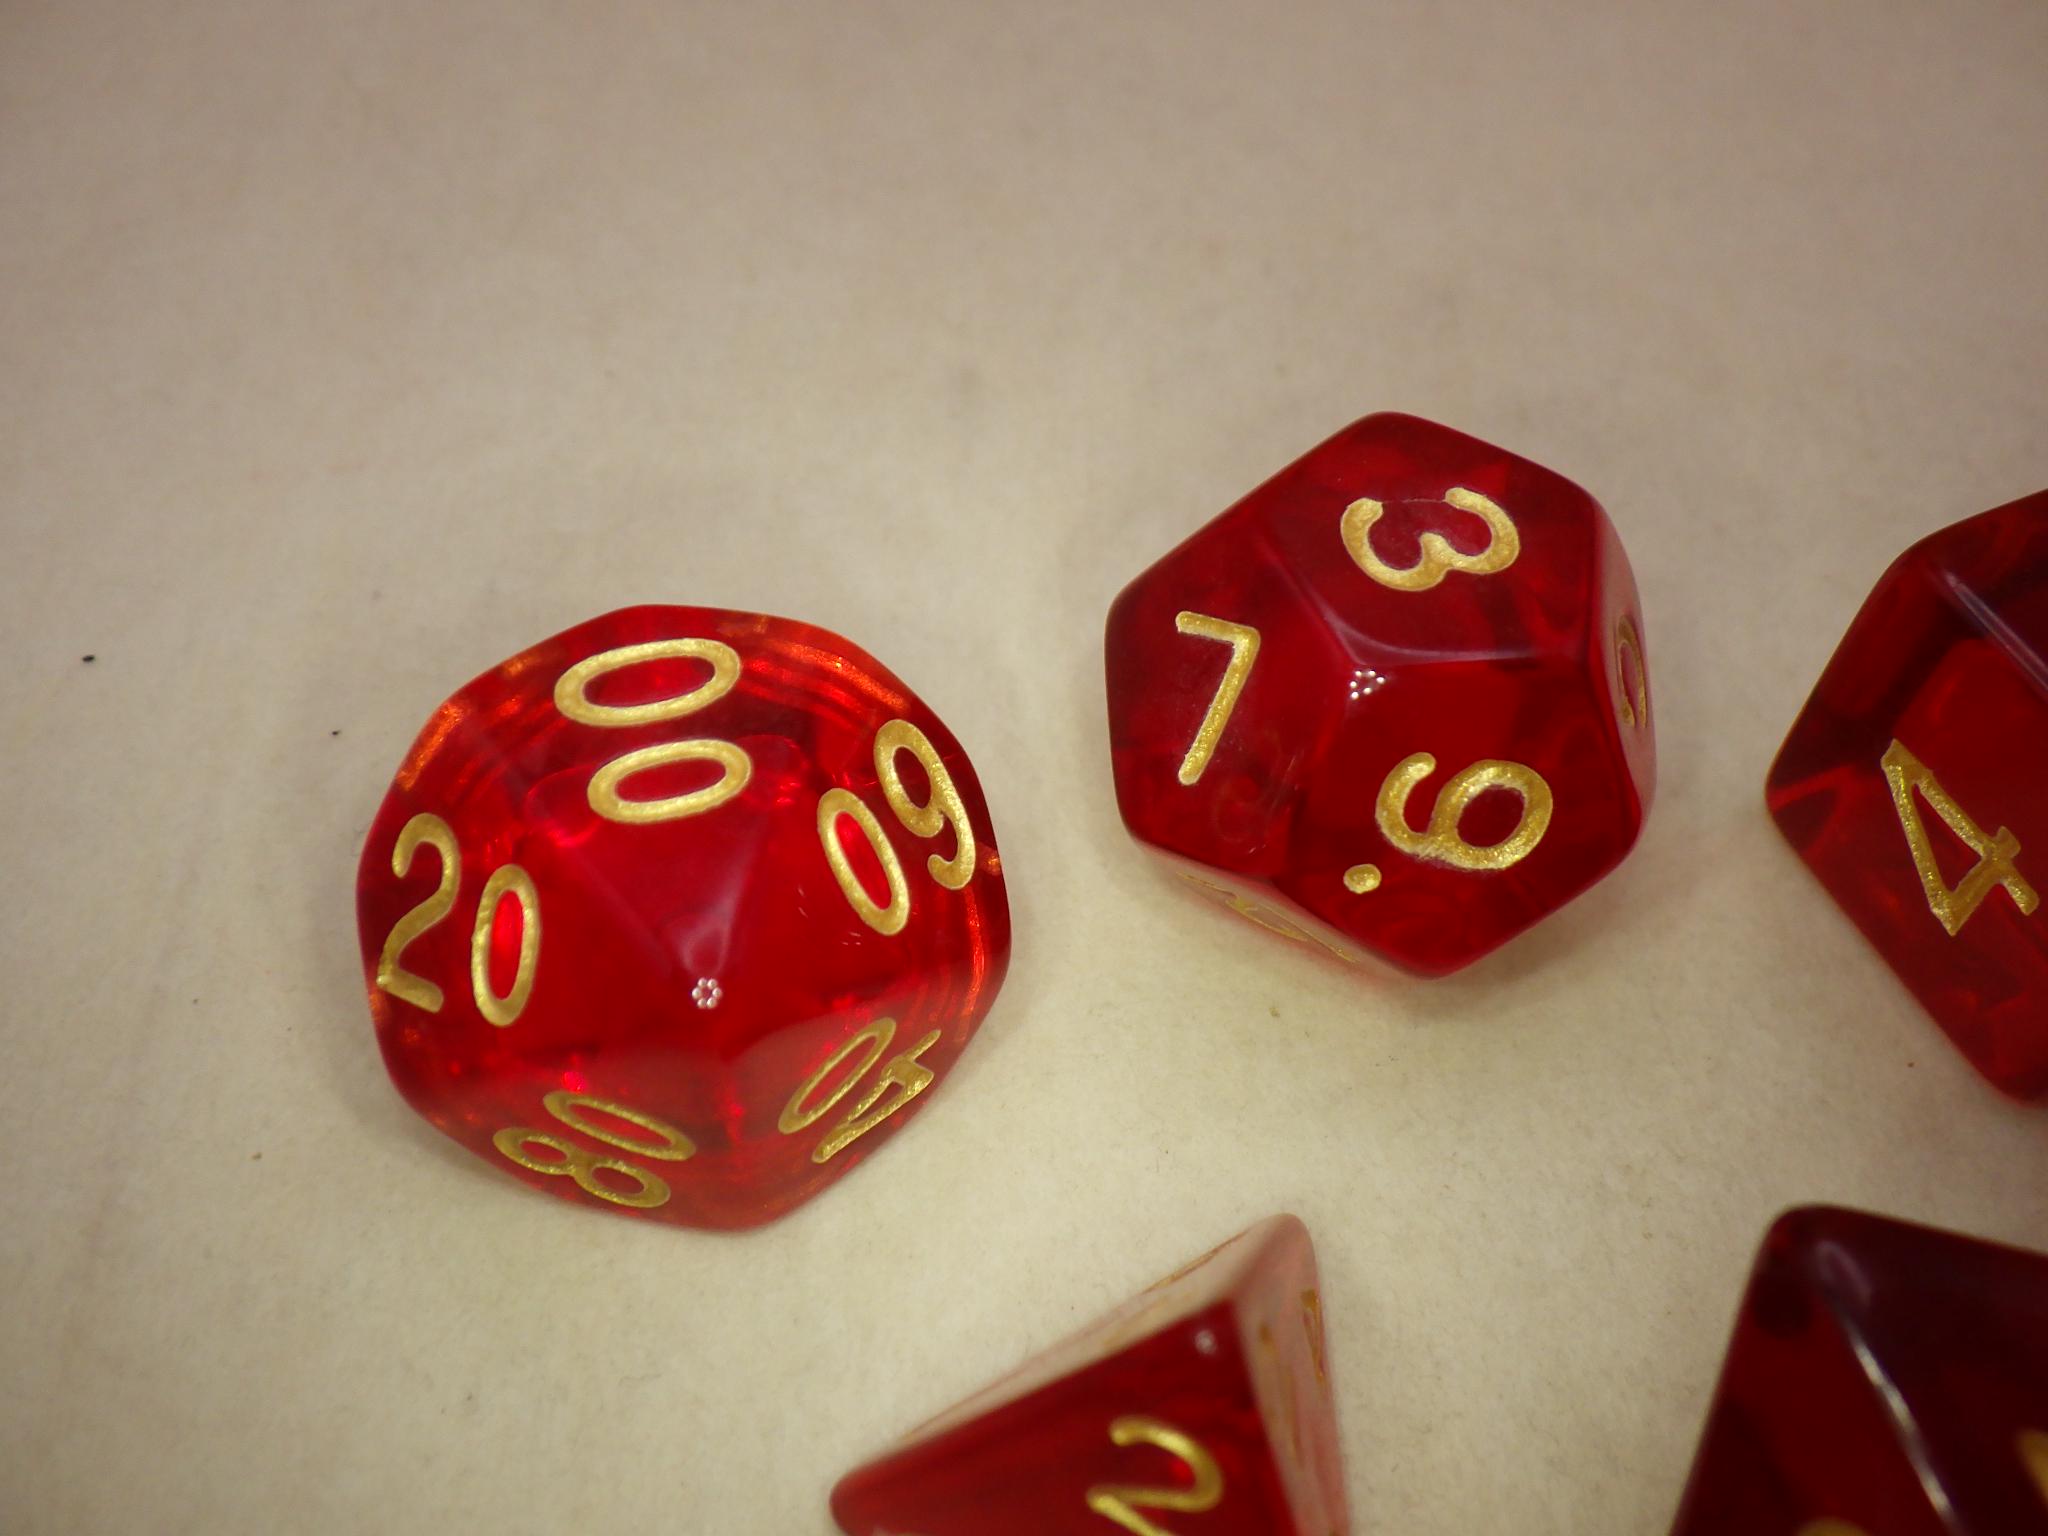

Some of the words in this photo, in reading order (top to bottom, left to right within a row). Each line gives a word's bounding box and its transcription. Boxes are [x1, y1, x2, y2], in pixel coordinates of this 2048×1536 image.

[1340, 487, 1520, 591] 3
[554, 637, 751, 824] 00
[1175, 611, 1261, 785] 7
[376, 812, 540, 1027] 20
[1880, 738, 2039, 936] 4
[493, 1091, 695, 1207] 80
[779, 1017, 941, 1164] 40
